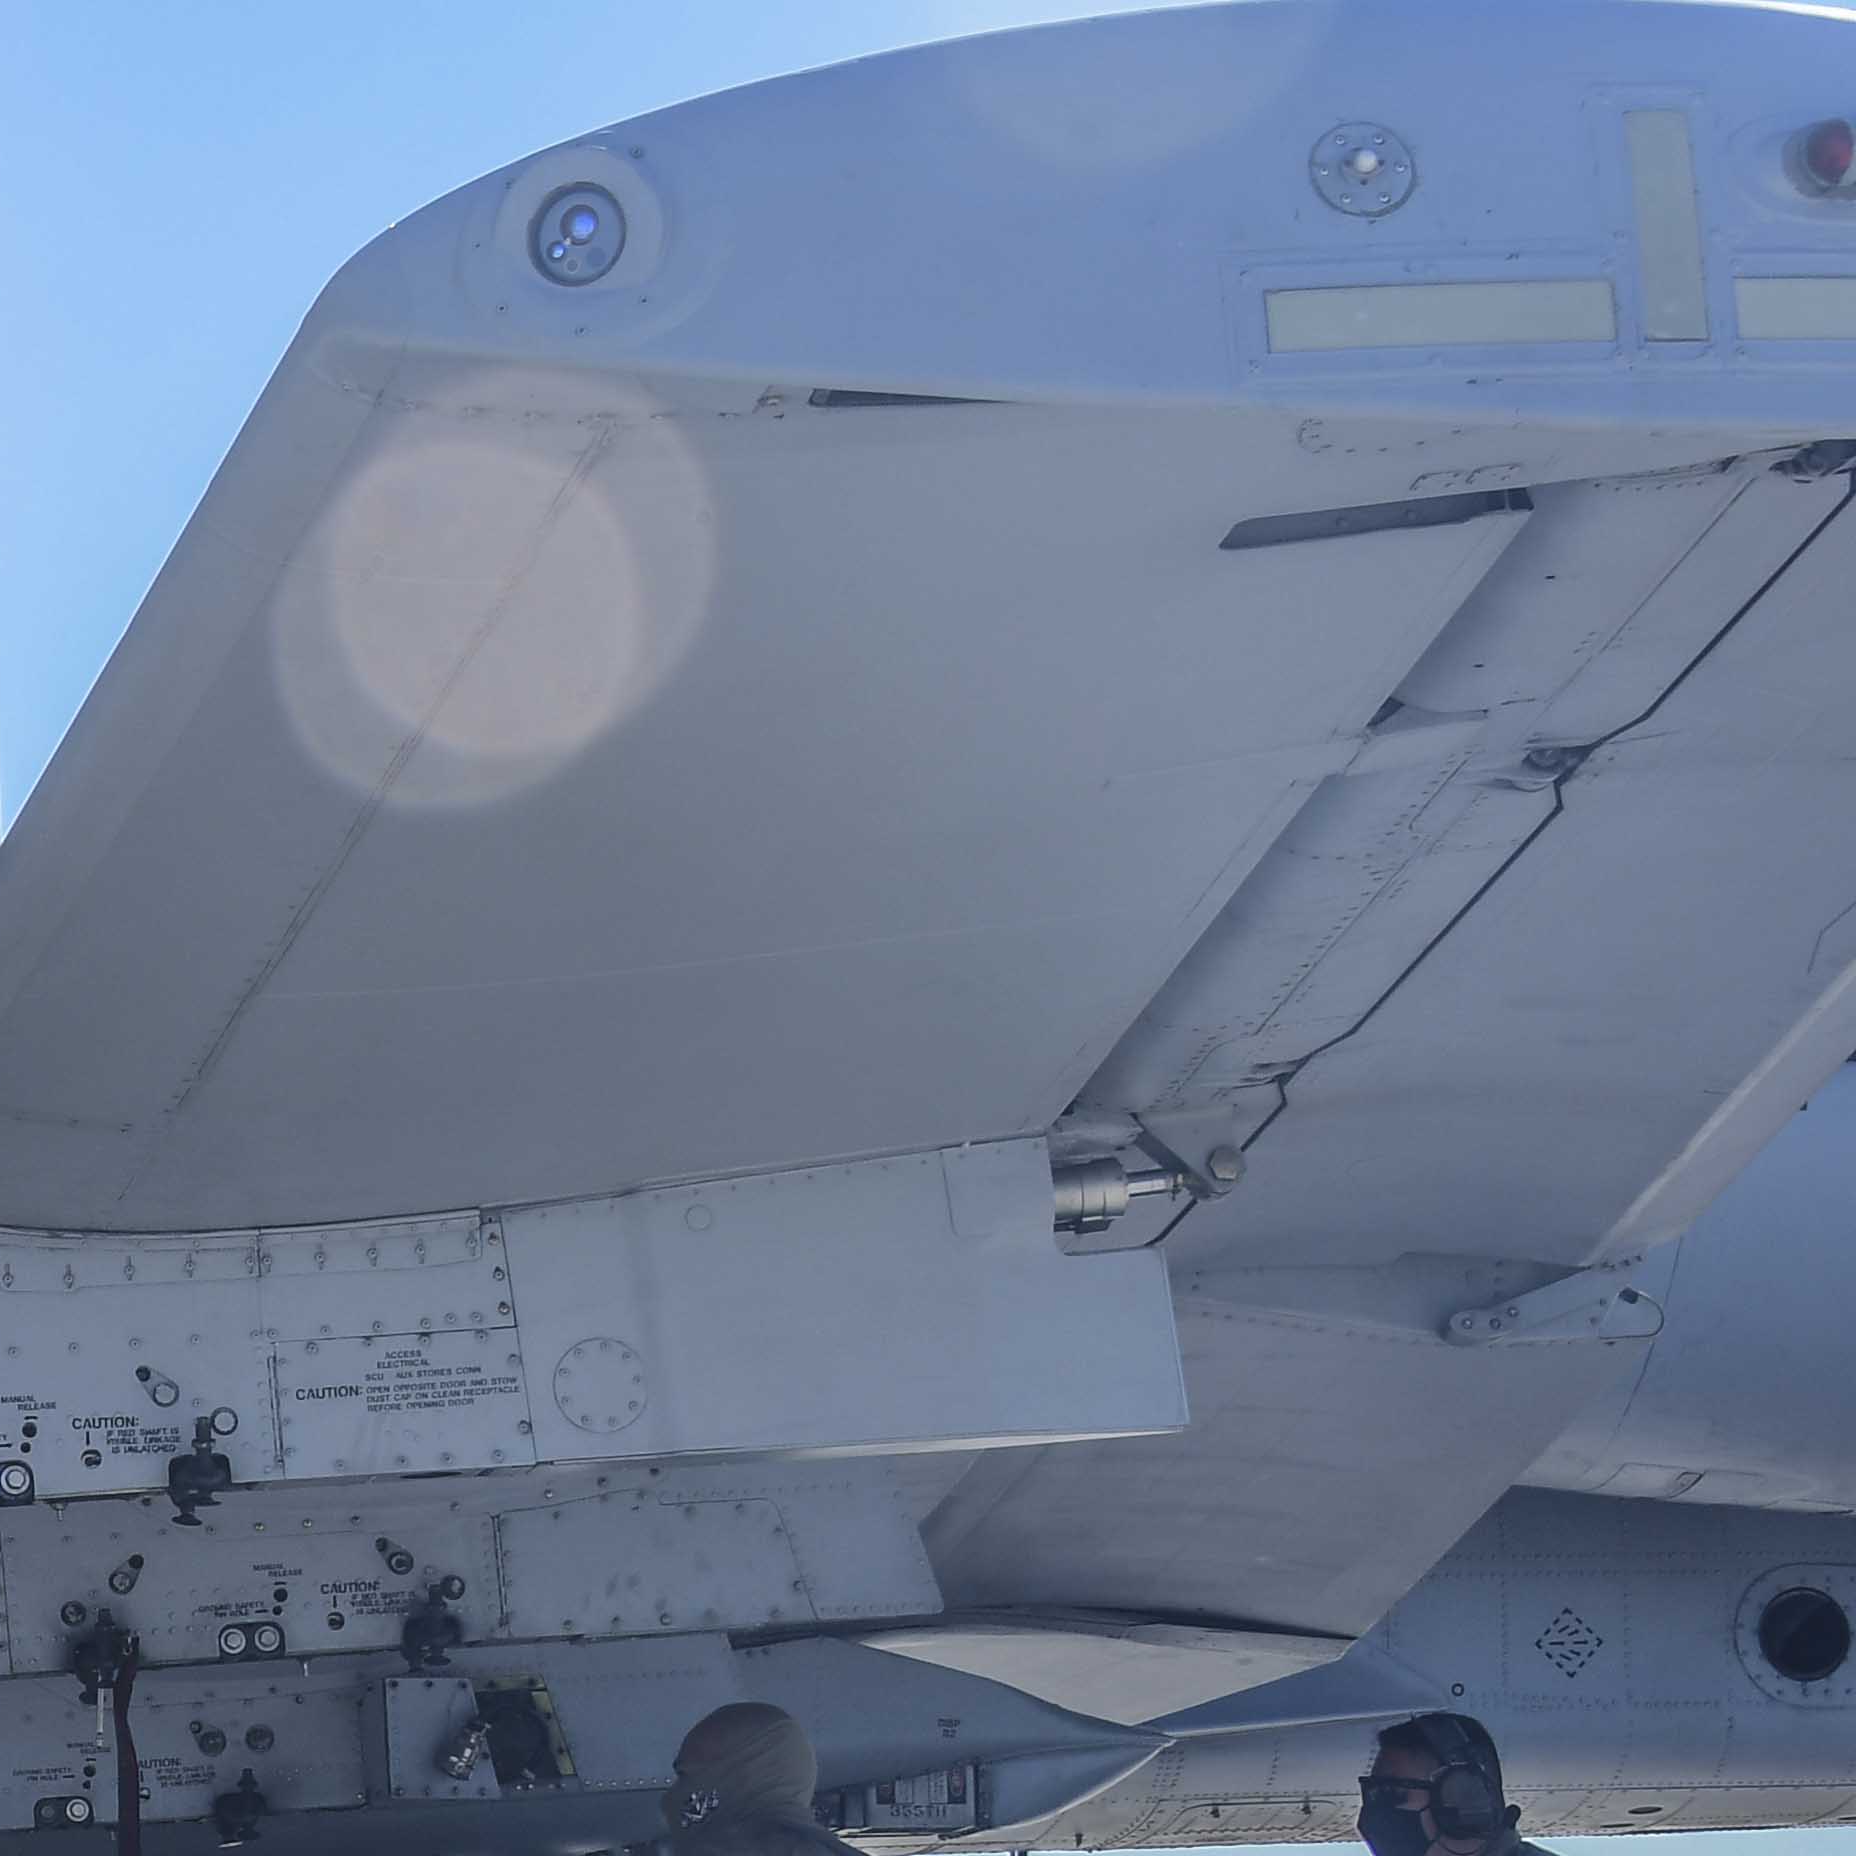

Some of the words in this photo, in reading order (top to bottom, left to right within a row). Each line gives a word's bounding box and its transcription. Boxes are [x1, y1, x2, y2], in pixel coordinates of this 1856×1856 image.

[384, 1350, 423, 1360] ACCESS
[376, 1360, 430, 1369] ELECTRICAL
[416, 1369, 452, 1378] STORES
[366, 1386, 390, 1394] OPEN
[393, 1382, 436, 1392] OPPOSITE
[439, 1380, 467, 1389] DOOR
[470, 1379, 488, 1387] AND
[491, 1377, 518, 1386] STOW
[1, 1395, 35, 1403] MANUAL
[295, 1385, 364, 1401] CAUTION:
[366, 1394, 390, 1403] DUST
[394, 1392, 412, 1401] CAP
[415, 1391, 429, 1400] ON
[432, 1389, 460, 1399] CLEAN
[463, 1385, 521, 1397] RECEPTACLE
[17, 1401, 57, 1410] RELEASE
[367, 1403, 403, 1412] BEFORE
[406, 1400, 446, 1410] OPENING
[448, 1398, 475, 1408] DOOR
[72, 1416, 139, 1430] CAUTION:
[320, 1581, 380, 1595] CAUTION:
[138, 1757, 181, 1769] AUTION:
